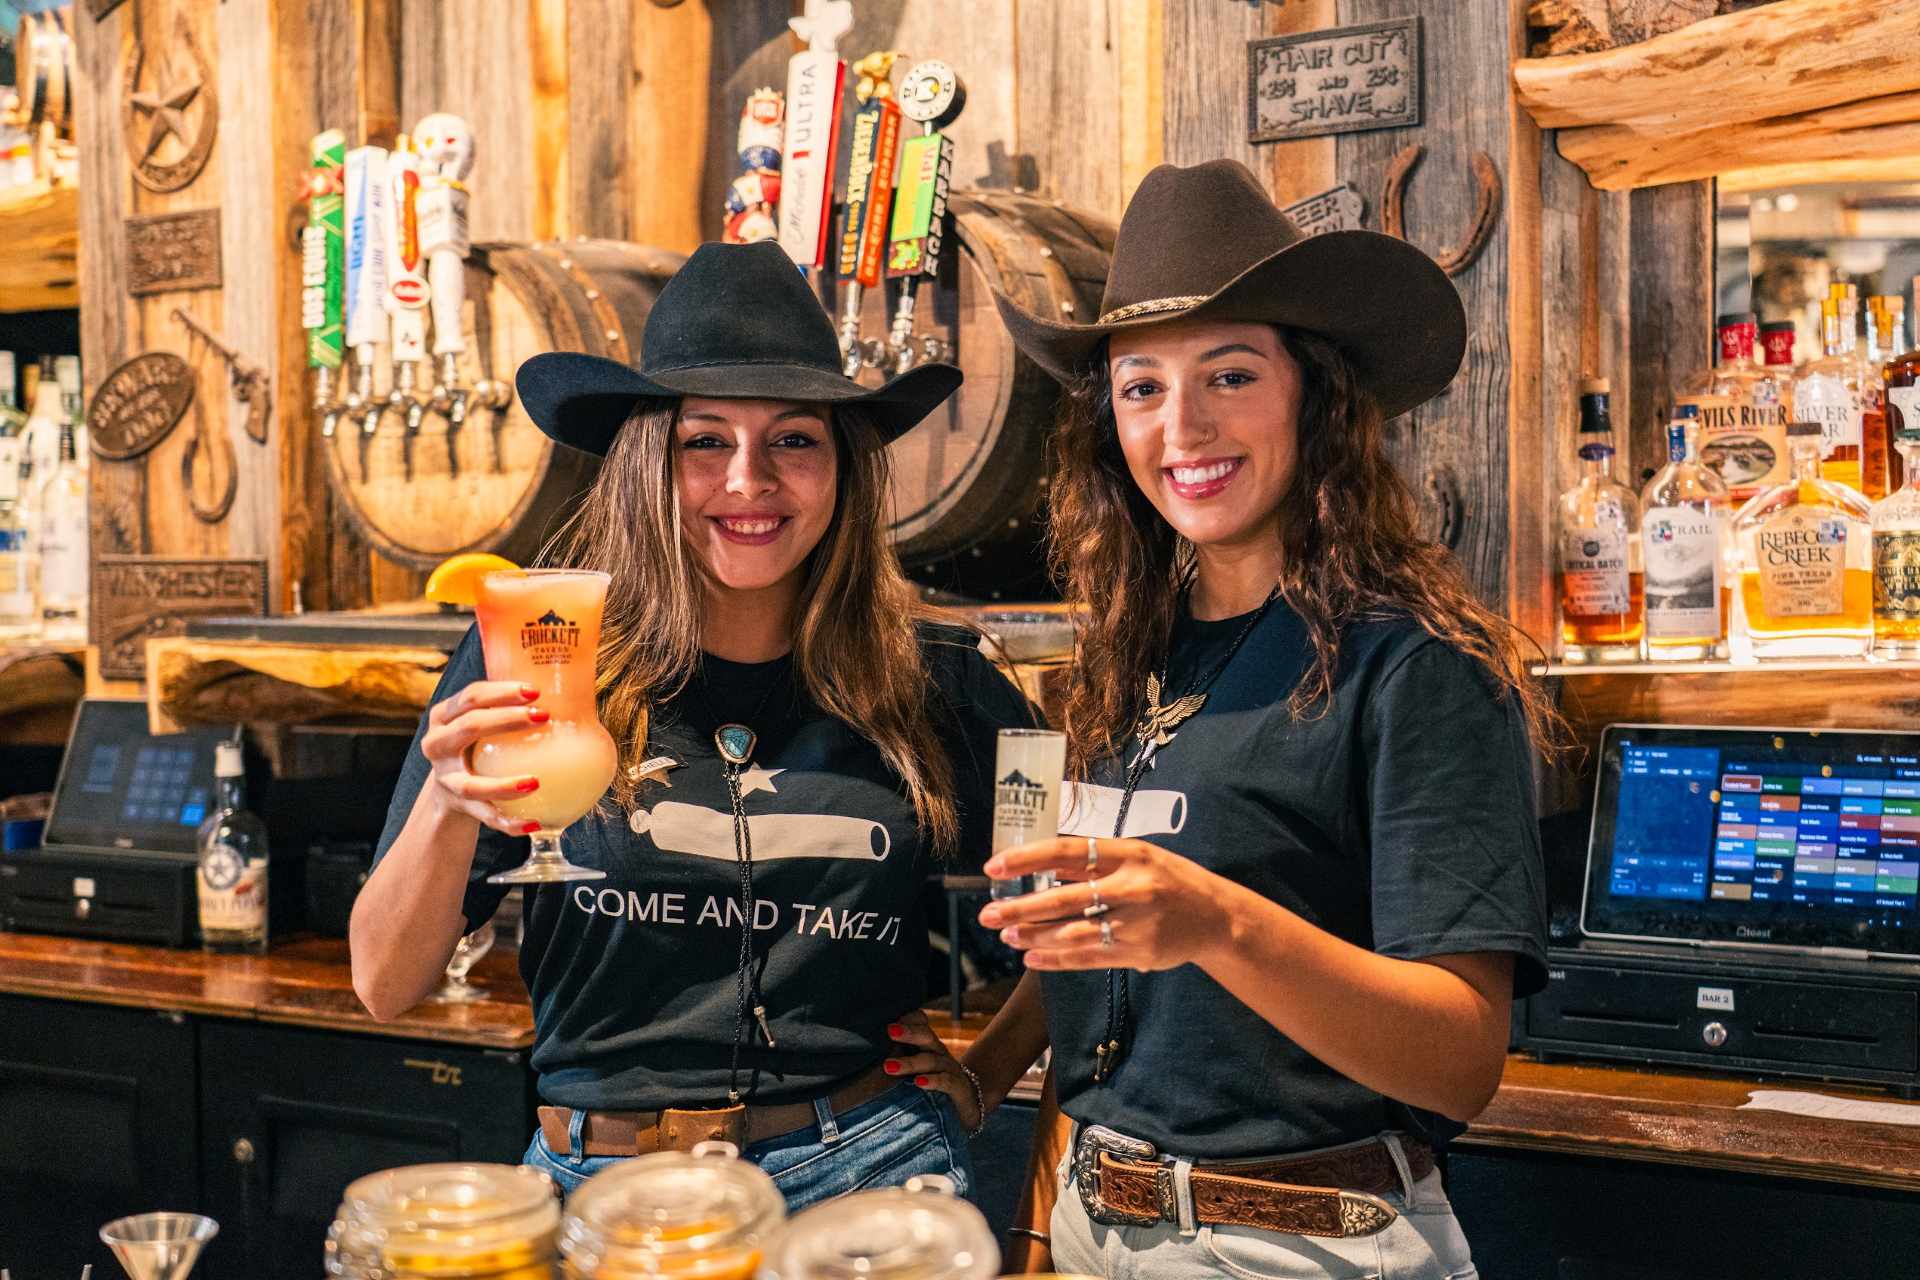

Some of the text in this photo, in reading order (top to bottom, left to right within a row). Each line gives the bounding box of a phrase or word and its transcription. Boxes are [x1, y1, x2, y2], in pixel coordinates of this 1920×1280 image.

[1275, 37, 1392, 73] HAIR CUT
[801, 64, 818, 143] ULTRA
[1290, 91, 1374, 119] SHAVE
[1699, 404, 1787, 428] VILS RIVER
[1760, 529, 1822, 551] REBEC
[1768, 547, 1831, 567] CREEK
[521, 627, 580, 649] CROCKETT
[996, 788, 1049, 811] OCKETT
[574, 886, 686, 924] COME
[696, 895, 779, 930] AND
[792, 903, 879, 941] TAKE
[1548, 970, 1566, 980] ast
[1702, 993, 1720, 1004] BAR
